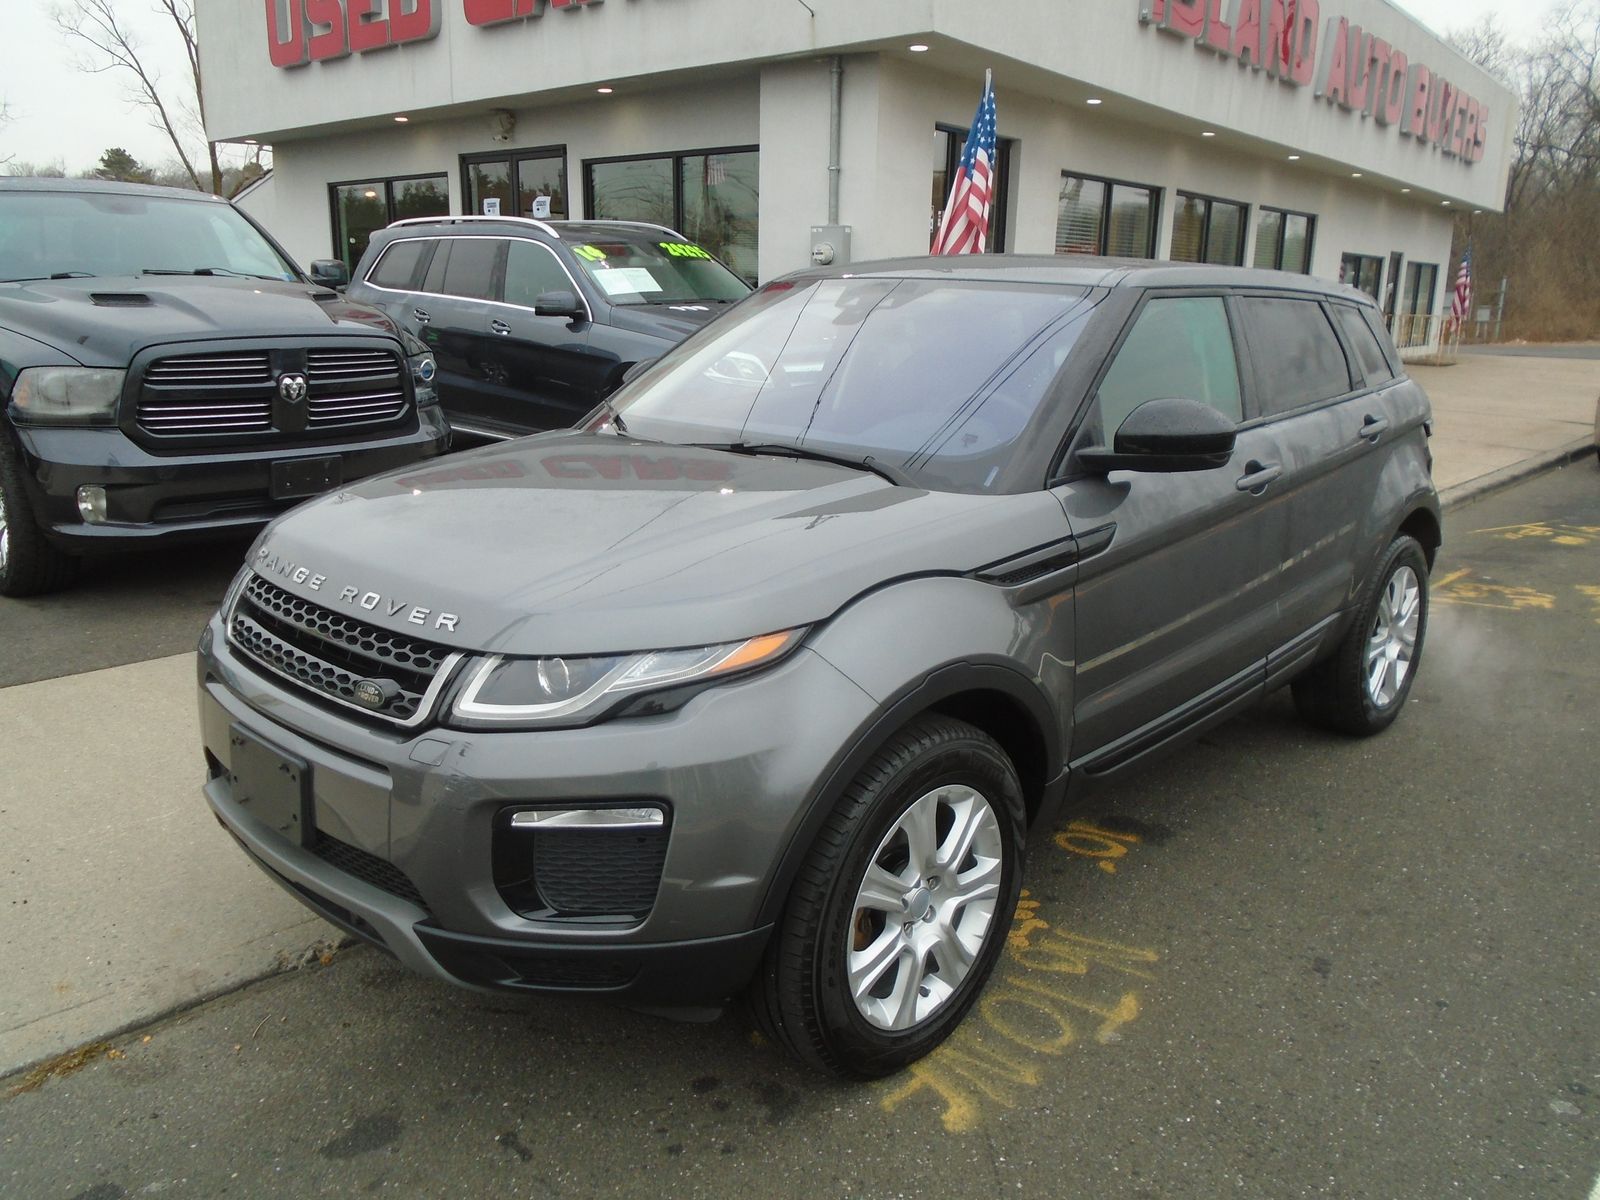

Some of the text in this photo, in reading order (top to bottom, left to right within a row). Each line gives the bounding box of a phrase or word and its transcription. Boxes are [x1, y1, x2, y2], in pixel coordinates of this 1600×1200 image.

[1142, 0, 1320, 87] LAND
[1315, 15, 1408, 126] AUTO
[257, 547, 460, 632] RANGE ROVER
